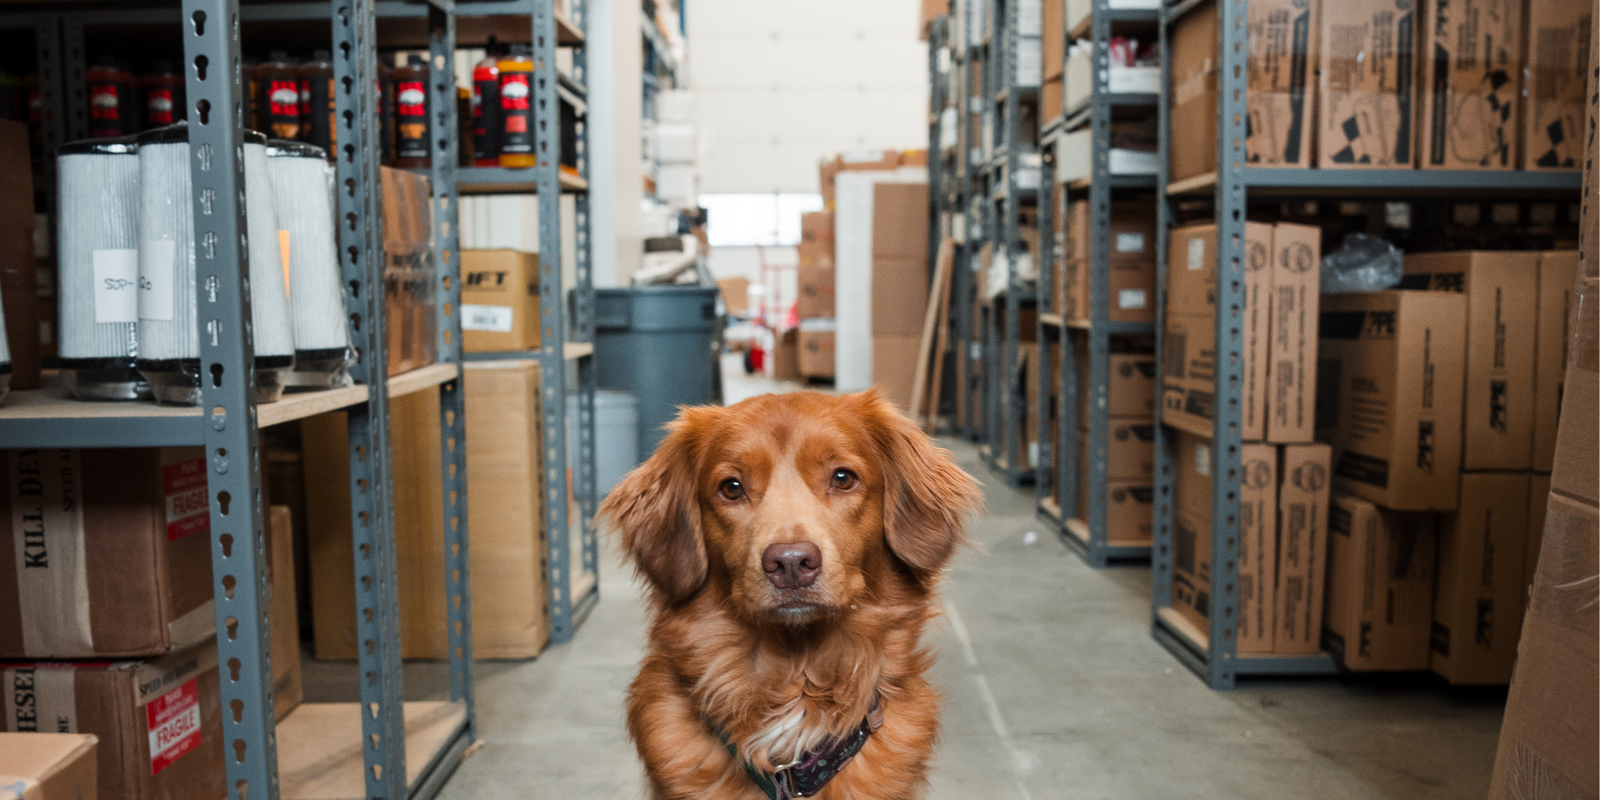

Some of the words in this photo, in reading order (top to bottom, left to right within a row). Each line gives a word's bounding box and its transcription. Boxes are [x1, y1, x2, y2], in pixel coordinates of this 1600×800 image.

[62, 468, 76, 512] SPEED
[23, 507, 48, 568] KILL
[156, 709, 195, 749] FRAGILE
